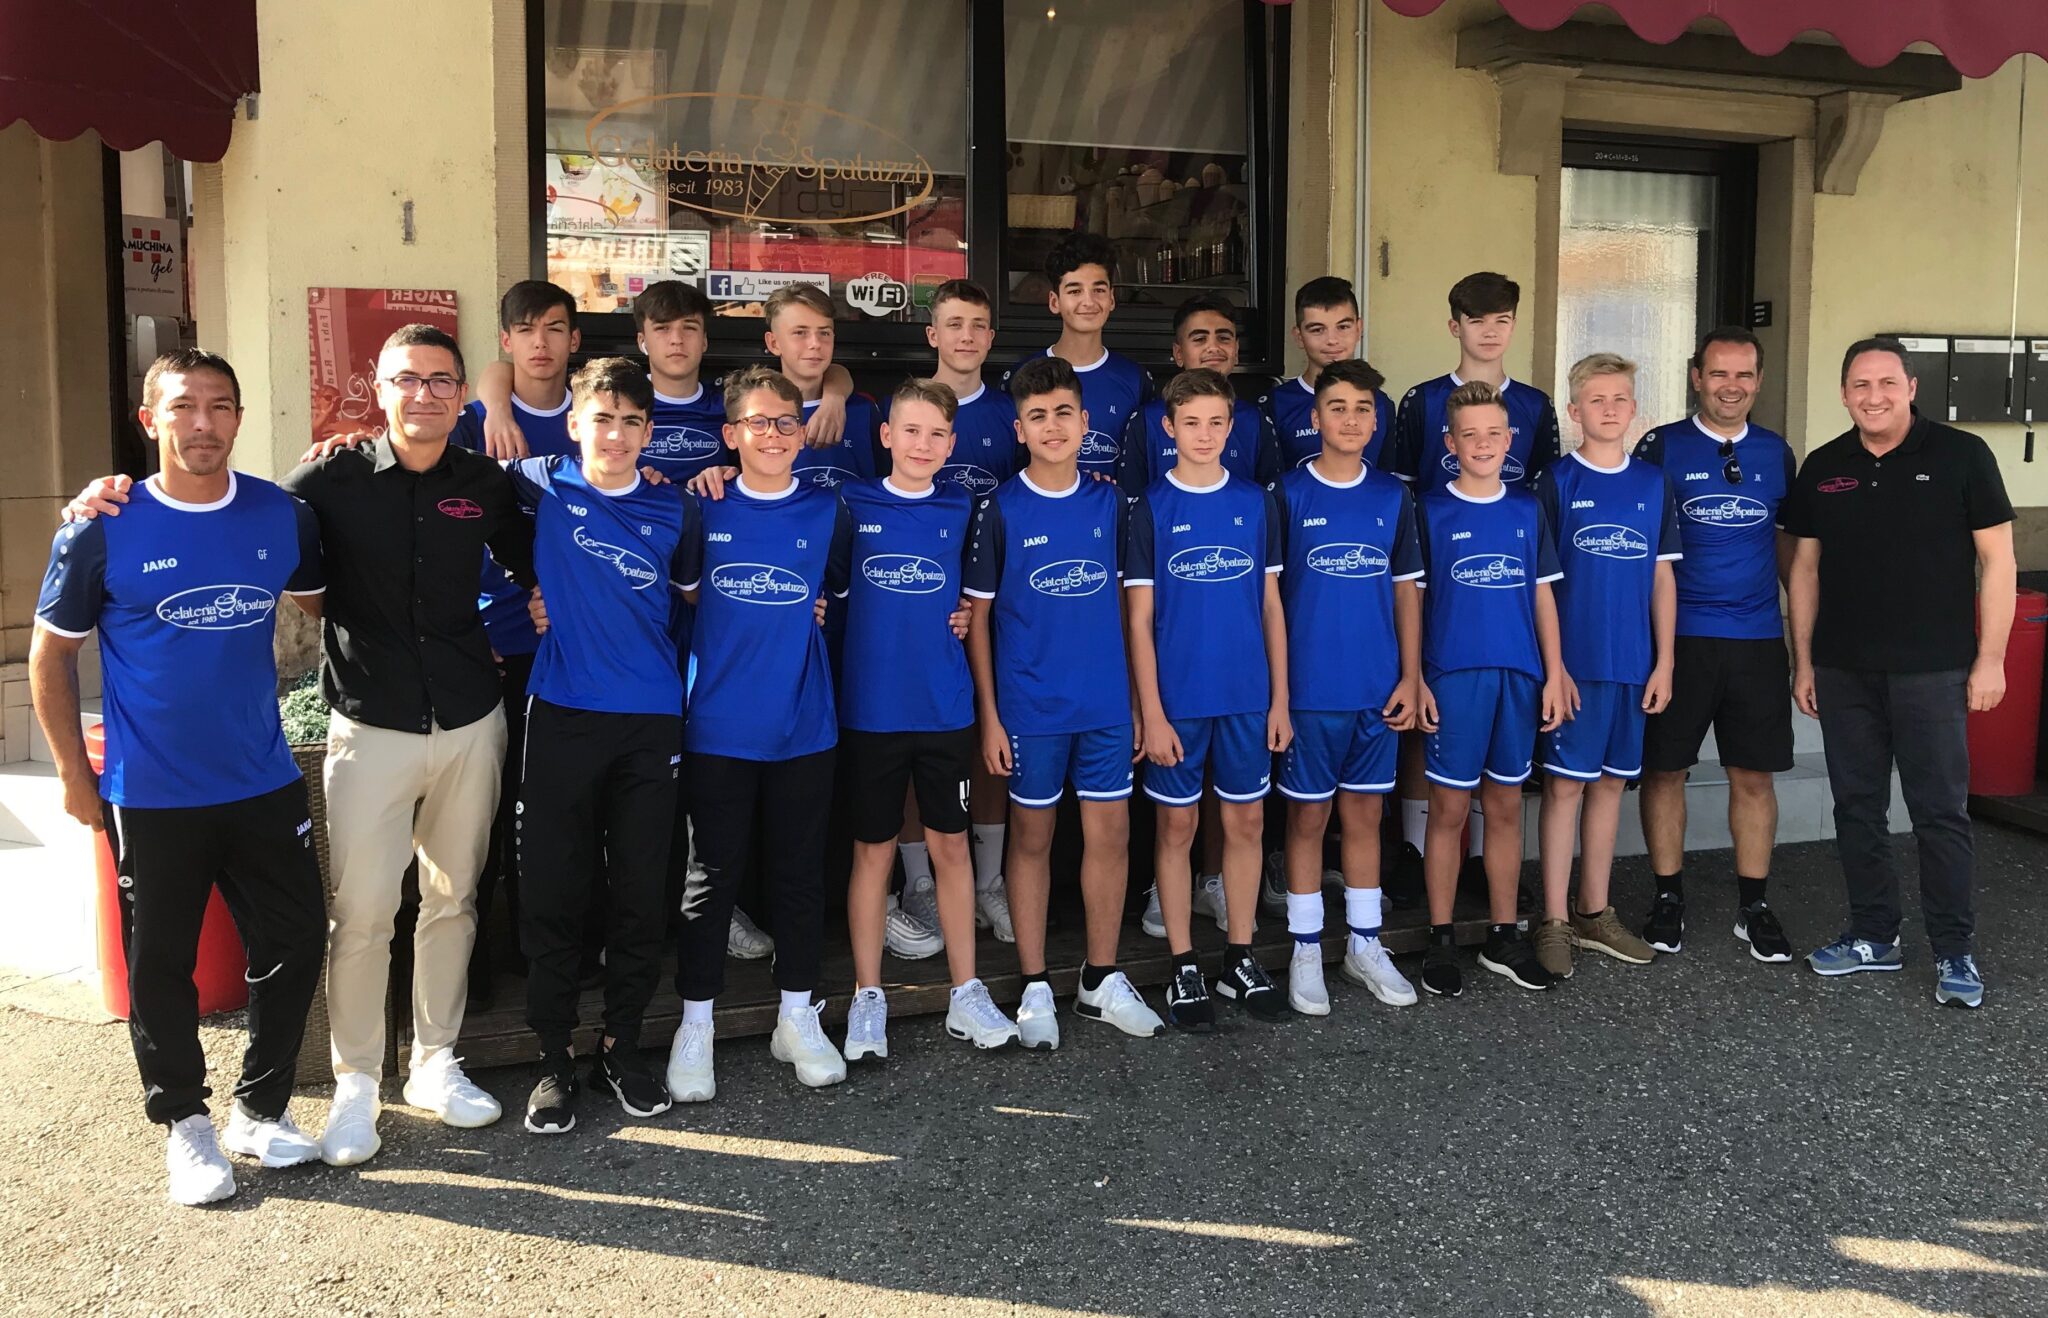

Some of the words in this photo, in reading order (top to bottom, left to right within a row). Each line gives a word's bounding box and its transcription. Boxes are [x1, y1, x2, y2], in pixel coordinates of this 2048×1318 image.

[593, 131, 744, 174] Gelateria
[795, 146, 923, 191] Spatuzzi
[668, 180, 696, 194] seit
[704, 179, 744, 196] 1983
[864, 272, 891, 283] FREE
[1162, 448, 1179, 457] JAK
[1684, 472, 1709, 481] JAKO
[1571, 500, 1595, 510] JAKO
[1302, 518, 1328, 528] JAKO
[858, 524, 882, 533] JAKO
[1172, 524, 1191, 533] JAKO
[708, 533, 732, 542] JAKO
[1451, 531, 1472, 540] JAKO
[796, 539, 807, 549] CH
[1023, 535, 1049, 548] JAKO
[257, 549, 268, 560] GF
[142, 557, 178, 573] JAKO
[713, 575, 752, 589] Gelateria
[159, 603, 216, 620] Gelateria
[201, 615, 218, 624] 1983
